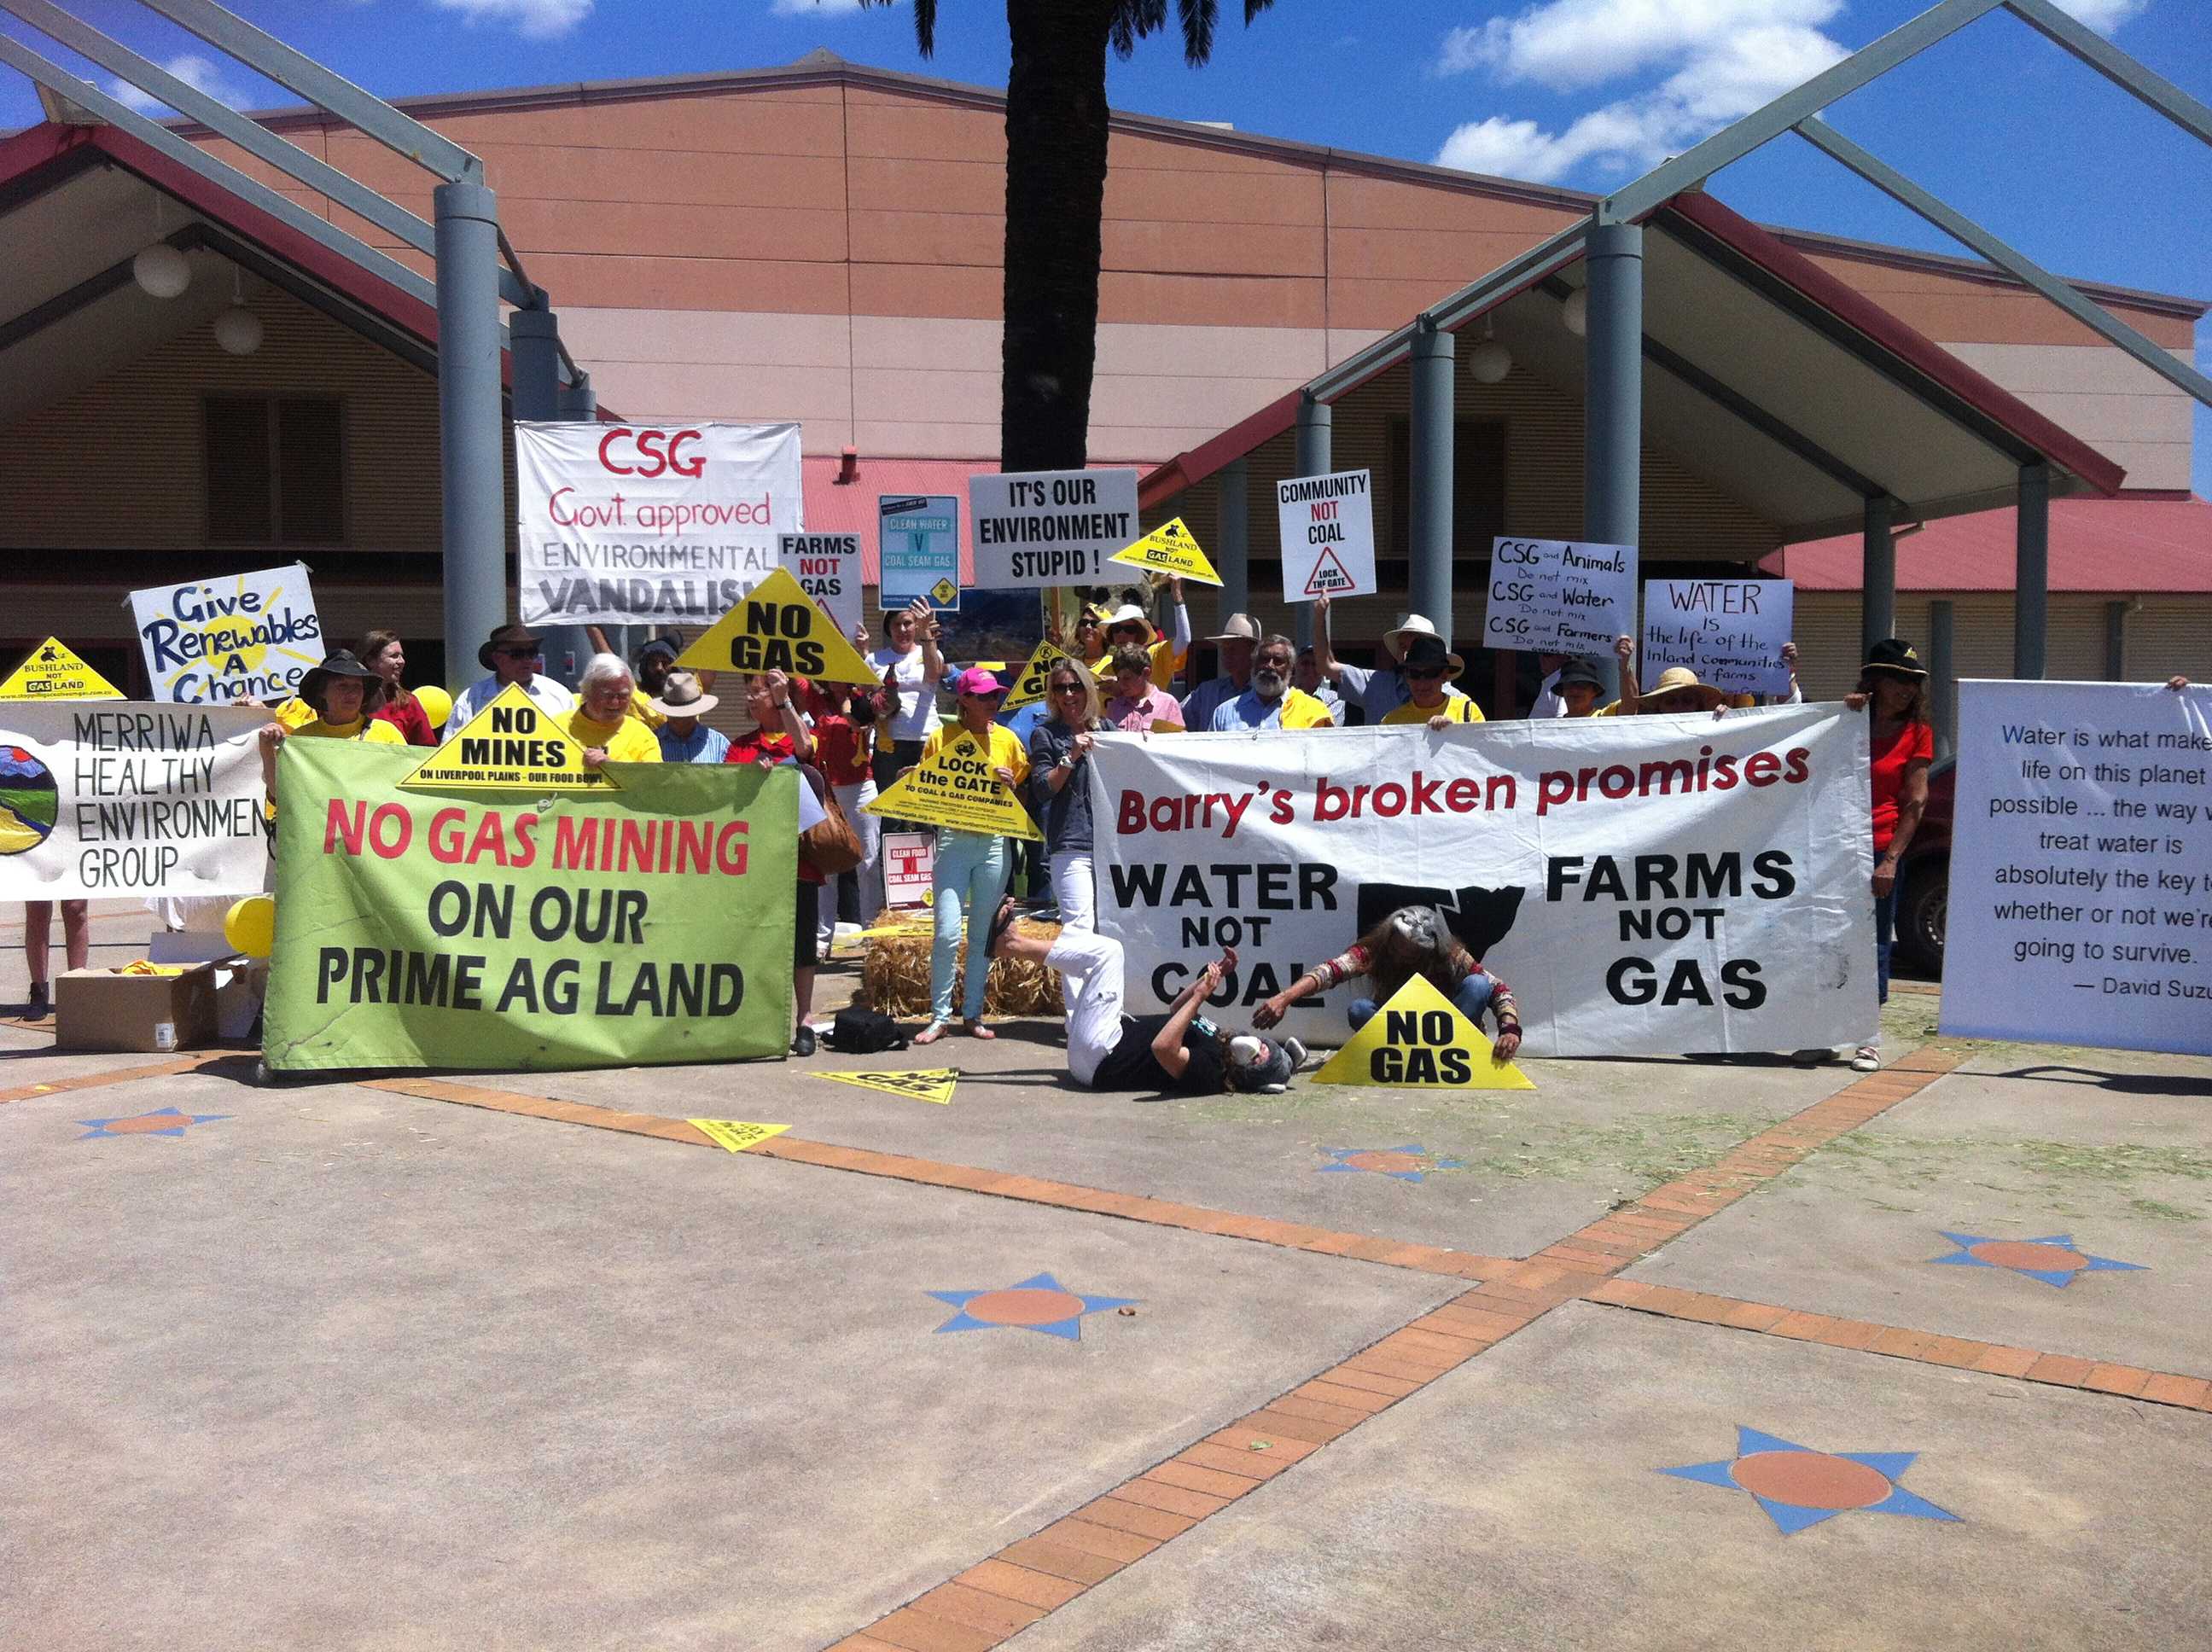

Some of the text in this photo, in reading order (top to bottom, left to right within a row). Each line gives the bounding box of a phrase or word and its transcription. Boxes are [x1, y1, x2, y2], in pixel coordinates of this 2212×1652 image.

[598, 428, 707, 478] CSG
[1010, 479, 1097, 507] IT'S OUR
[1281, 474, 1366, 503] COMMUNITY
[637, 492, 771, 537] approved
[890, 518, 947, 530] CLEAN WATER
[1311, 501, 1338, 522] NOT
[980, 513, 1130, 544] ENVIRONMENT
[1308, 523, 1345, 544] COAL
[543, 542, 777, 570] ENVIRONMENTAL
[783, 537, 856, 555] FARMS
[1150, 535, 1197, 551] BUSHLAND
[800, 558, 840, 575] NOT
[885, 555, 951, 567] COAL SEAM GAS
[1012, 550, 1086, 578] STUPID
[1148, 550, 1167, 563] GAS
[1168, 556, 1193, 567] LAND
[1499, 541, 1540, 565] CSG
[1563, 545, 1626, 573] Animals
[1313, 578, 1346, 589] THE GATE
[1318, 568, 1338, 579] LOCK
[1517, 567, 1588, 585] Do not mix
[800, 579, 841, 596] GAS
[1493, 581, 1614, 607] CSG and Water
[1669, 582, 1761, 614] WATER
[173, 586, 261, 622] Give
[1518, 603, 1586, 621] Do not mix
[748, 601, 811, 639] NO
[1489, 616, 1530, 633] CSG
[1557, 623, 1614, 643] Farmers
[142, 608, 320, 672] Renewables
[1513, 635, 1534, 644] Do
[1566, 642, 1585, 650] mix
[1646, 625, 1768, 651] the life of the
[24, 663, 84, 672] BUSHLAND
[223, 654, 248, 677] A
[731, 636, 825, 675] GAS
[28, 681, 84, 691] GAS LAND
[173, 667, 304, 704] Chance
[1713, 668, 1755, 682] farms
[74, 713, 214, 753] MERRIWA
[492, 707, 537, 735] NO
[2003, 725, 2065, 745] Water
[2074, 728, 2089, 747] is
[2098, 730, 2149, 748] what
[462, 738, 566, 768] MINES
[939, 756, 988, 777] LOCK
[75, 756, 215, 796] HEALTHY
[420, 770, 434, 779] ON
[435, 771, 486, 781] LIVERPOOL
[487, 771, 521, 782] PLAINS
[528, 772, 548, 782] OUR
[550, 773, 573, 783] FOOD
[919, 770, 1002, 794] the GATE
[1313, 771, 1516, 822] broken
[1536, 745, 1811, 816] promises
[2022, 760, 2205, 787] life on this planet
[917, 787, 939, 796] COAL
[949, 791, 965, 800] GAS
[967, 794, 1014, 807] COMPANIES
[1989, 796, 2078, 817] possible
[2113, 799, 2146, 817] the
[2156, 805, 2197, 824] way
[323, 799, 749, 876] NO GAS MINING
[2040, 831, 2182, 854] treat water is
[79, 846, 178, 887] GROUP
[893, 848, 911, 858] CLEAN
[904, 874, 919, 882] SEAM
[1109, 863, 1339, 910] WATER
[1546, 850, 1796, 901] FARMS
[1995, 865, 2107, 892] absolutely
[2116, 869, 2149, 888] the
[2158, 870, 2196, 896] key
[428, 880, 649, 945] ON OUR
[1619, 907, 1725, 941] NOT
[1994, 901, 2082, 922] whether
[2092, 907, 2112, 923] or
[2122, 908, 2156, 926] not
[1181, 916, 1272, 948] NOT
[2014, 938, 2197, 965] going to survive.
[316, 947, 745, 1018] PRIME AG LAND
[1151, 962, 1325, 1009] COAL
[1605, 957, 1767, 1010] GAS
[2103, 977, 2161, 997] David
[1386, 1010, 1453, 1046] NO
[1371, 1047, 1472, 1084] GAS
